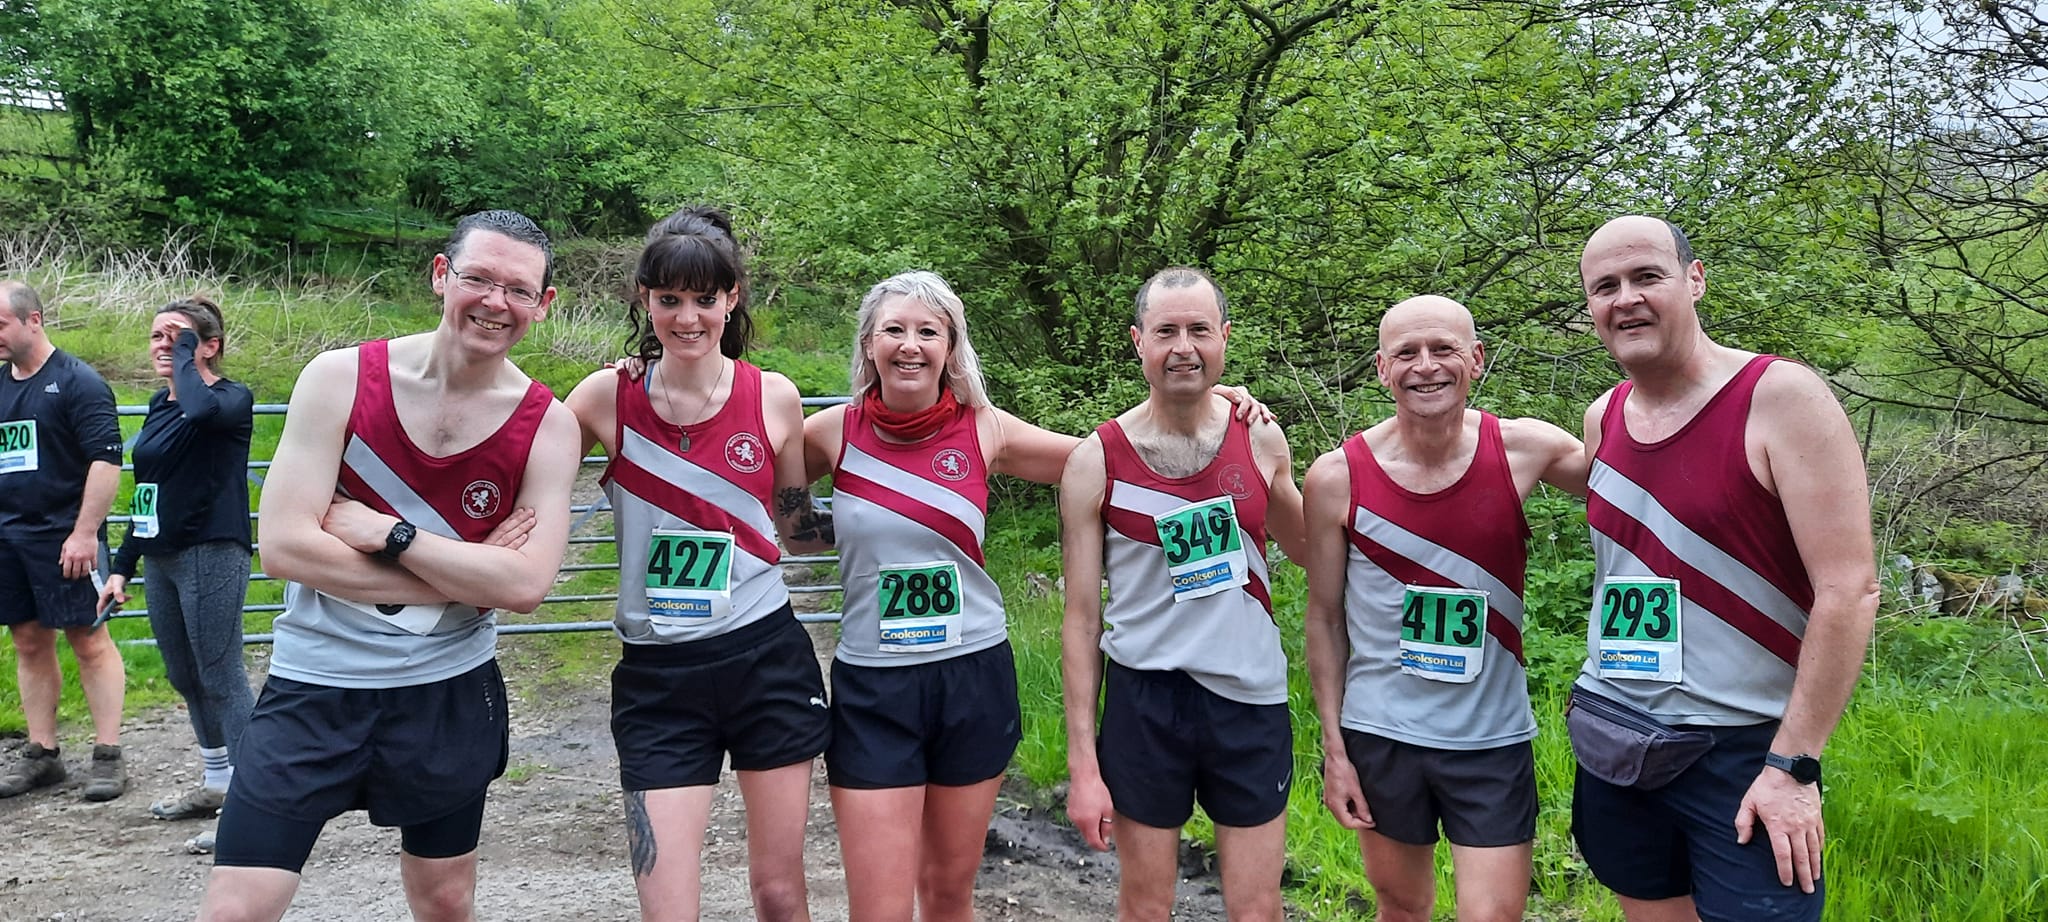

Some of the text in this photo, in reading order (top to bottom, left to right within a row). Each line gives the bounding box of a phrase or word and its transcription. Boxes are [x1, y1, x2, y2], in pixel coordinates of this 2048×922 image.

[0, 425, 30, 452] 420
[1162, 507, 1231, 563] 349
[647, 539, 727, 587] 427
[1172, 569, 1217, 586] Cookson
[1217, 567, 1229, 575] Ltd
[647, 599, 709, 611] Cookson Ltd
[882, 570, 955, 617] 288
[1402, 596, 1478, 645] 413
[1602, 587, 1671, 639] 293
[881, 628, 945, 640] Cookson Ltd
[1400, 650, 1448, 665] Cookson
[1600, 651, 1642, 662] Cookson
